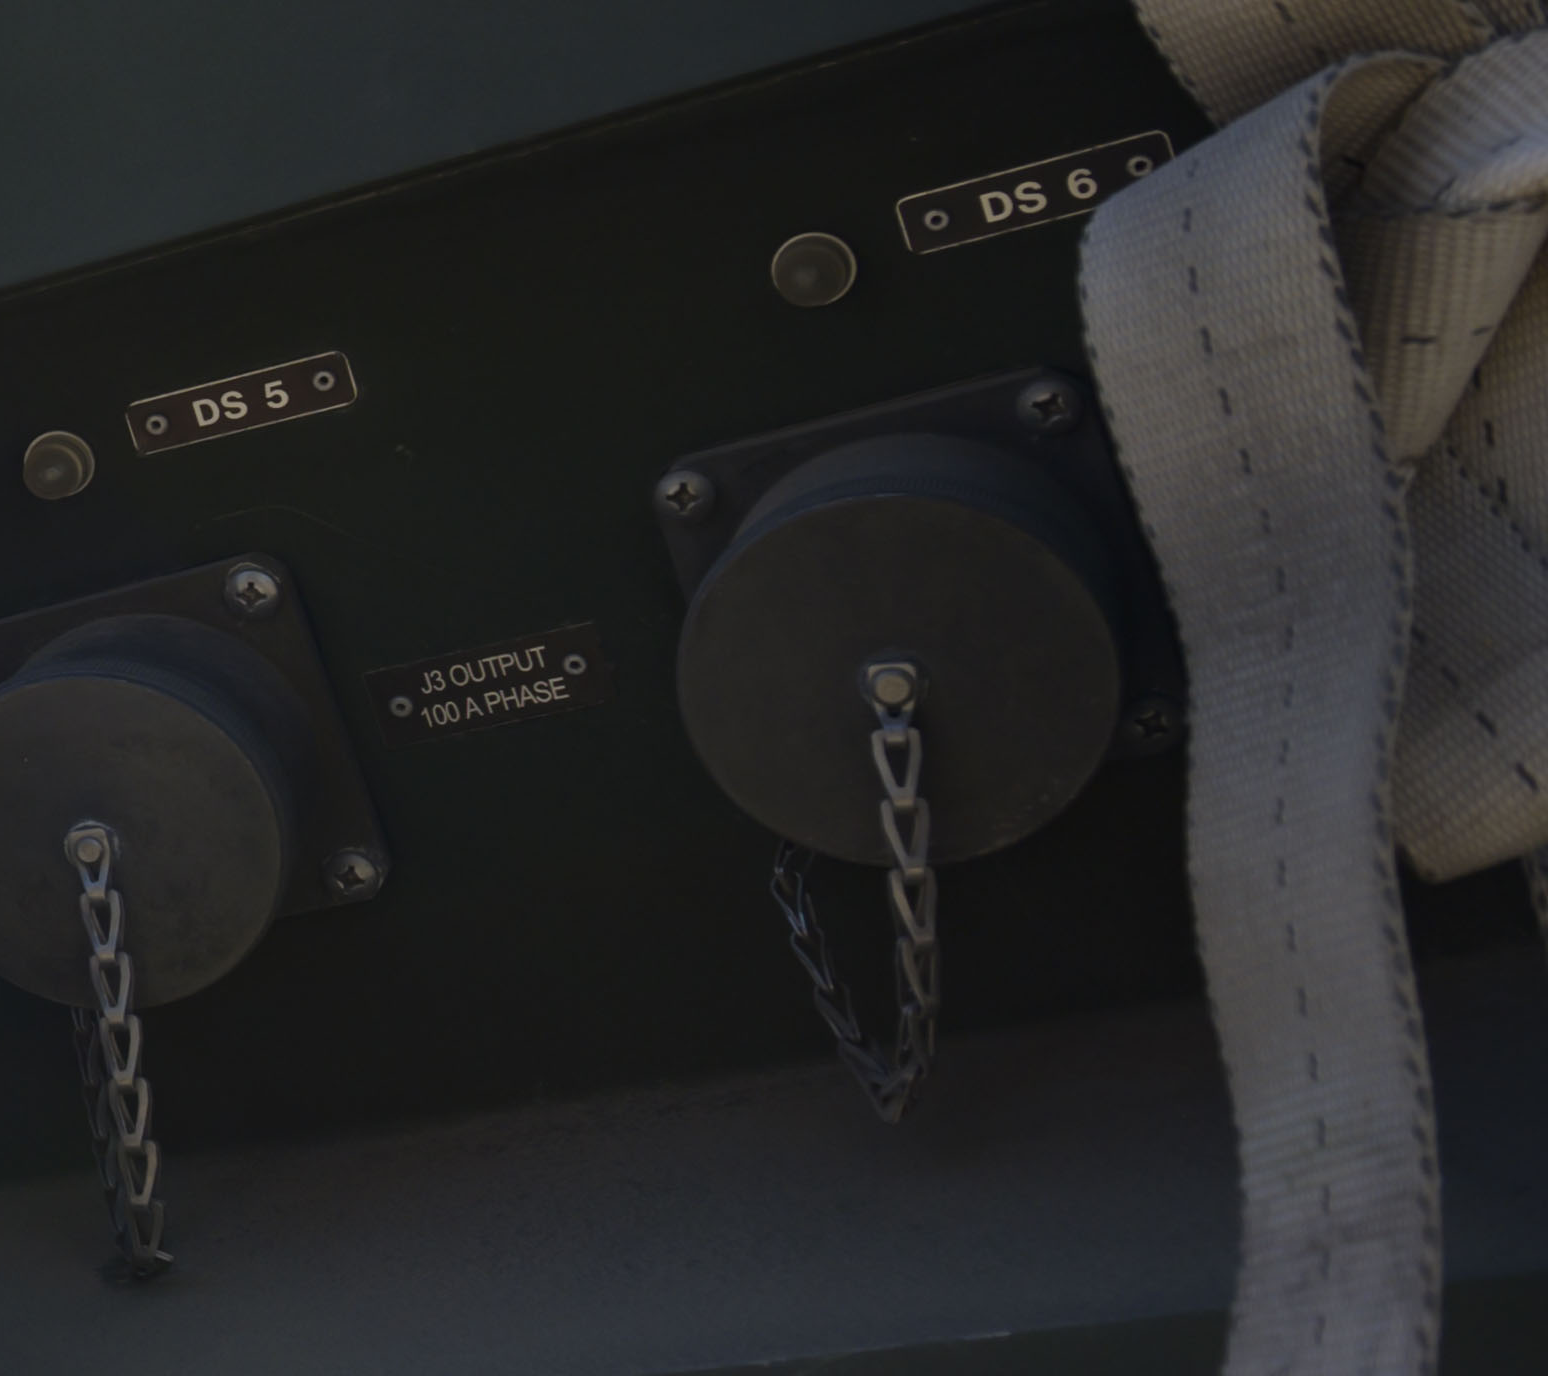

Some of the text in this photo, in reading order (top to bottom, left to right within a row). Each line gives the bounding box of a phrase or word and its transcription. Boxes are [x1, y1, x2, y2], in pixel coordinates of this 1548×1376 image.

[979, 168, 1098, 224] DS 6
[191, 380, 290, 427] DS 5
[420, 645, 547, 695] J3 OUTPUT
[420, 677, 570, 728] 100 A PHASE
